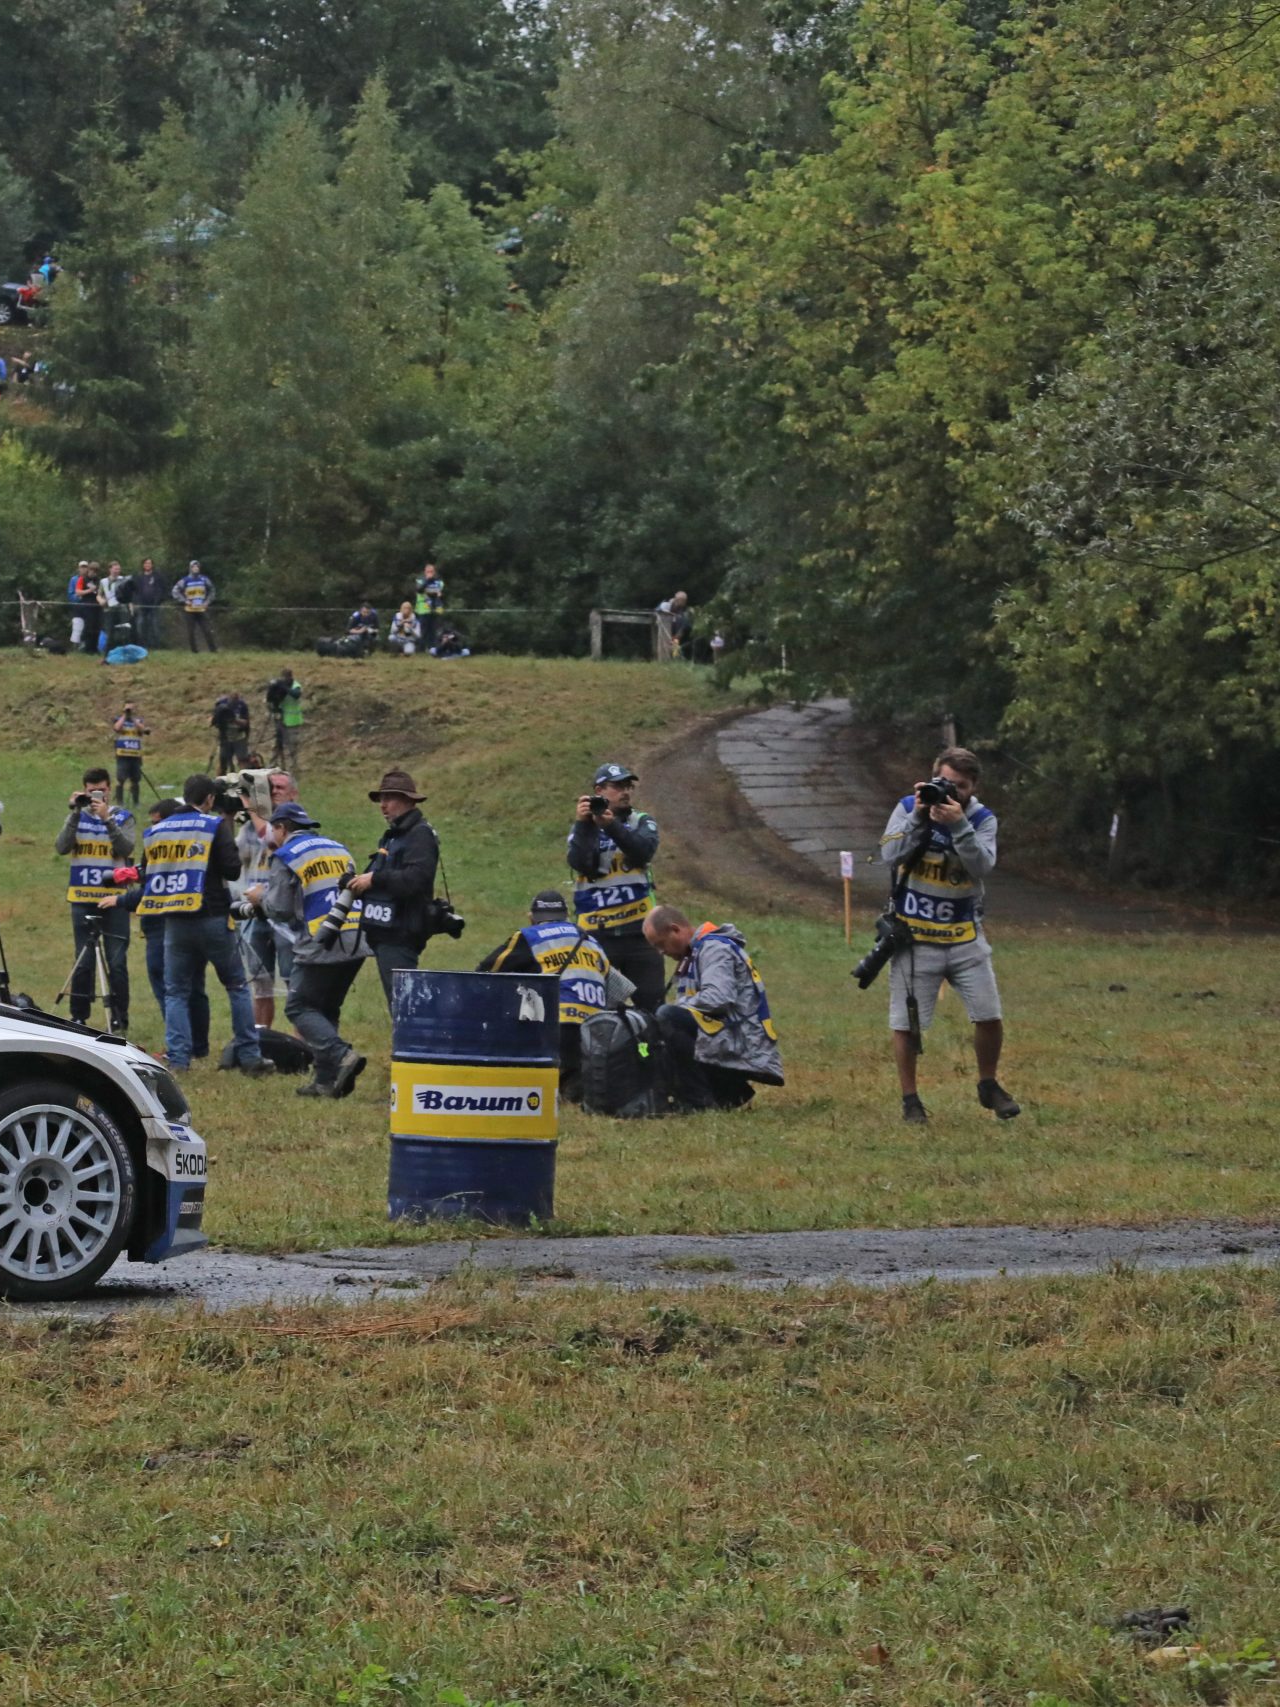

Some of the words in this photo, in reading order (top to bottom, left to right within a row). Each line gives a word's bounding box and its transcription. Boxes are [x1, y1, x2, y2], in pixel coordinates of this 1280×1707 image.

[150, 873, 188, 894] 059
[591, 885, 635, 908] 121
[364, 905, 392, 922] 003
[571, 981, 607, 1008] 100
[416, 1090, 523, 1112] Barum
